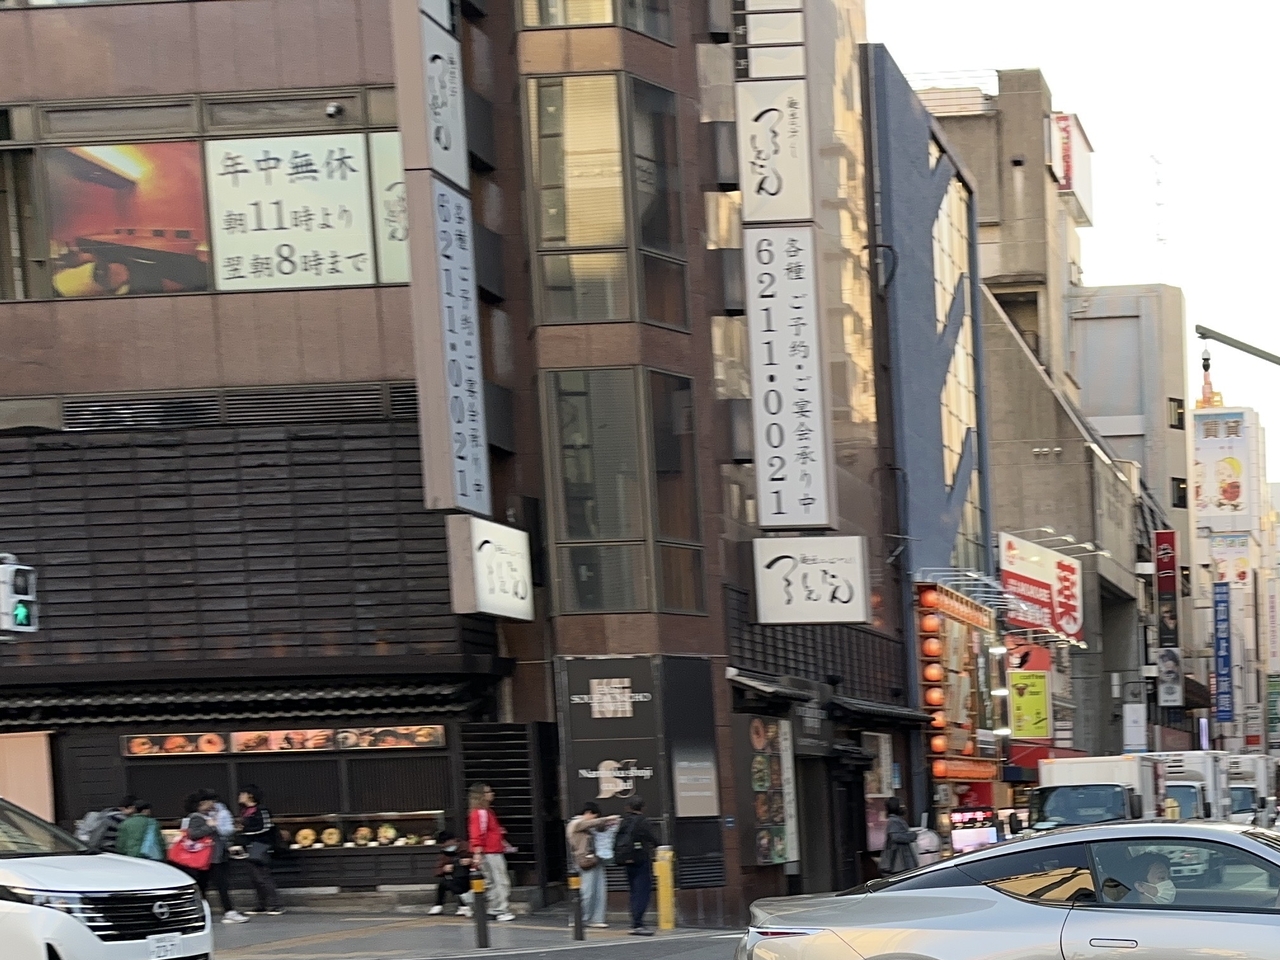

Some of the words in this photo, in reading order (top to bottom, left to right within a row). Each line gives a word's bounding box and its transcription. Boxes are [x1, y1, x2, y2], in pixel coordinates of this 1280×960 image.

[218, 147, 359, 187] 年中無休
[222, 200, 353, 234] 朝11時より
[222, 243, 369, 280] 翌朝8時まで
